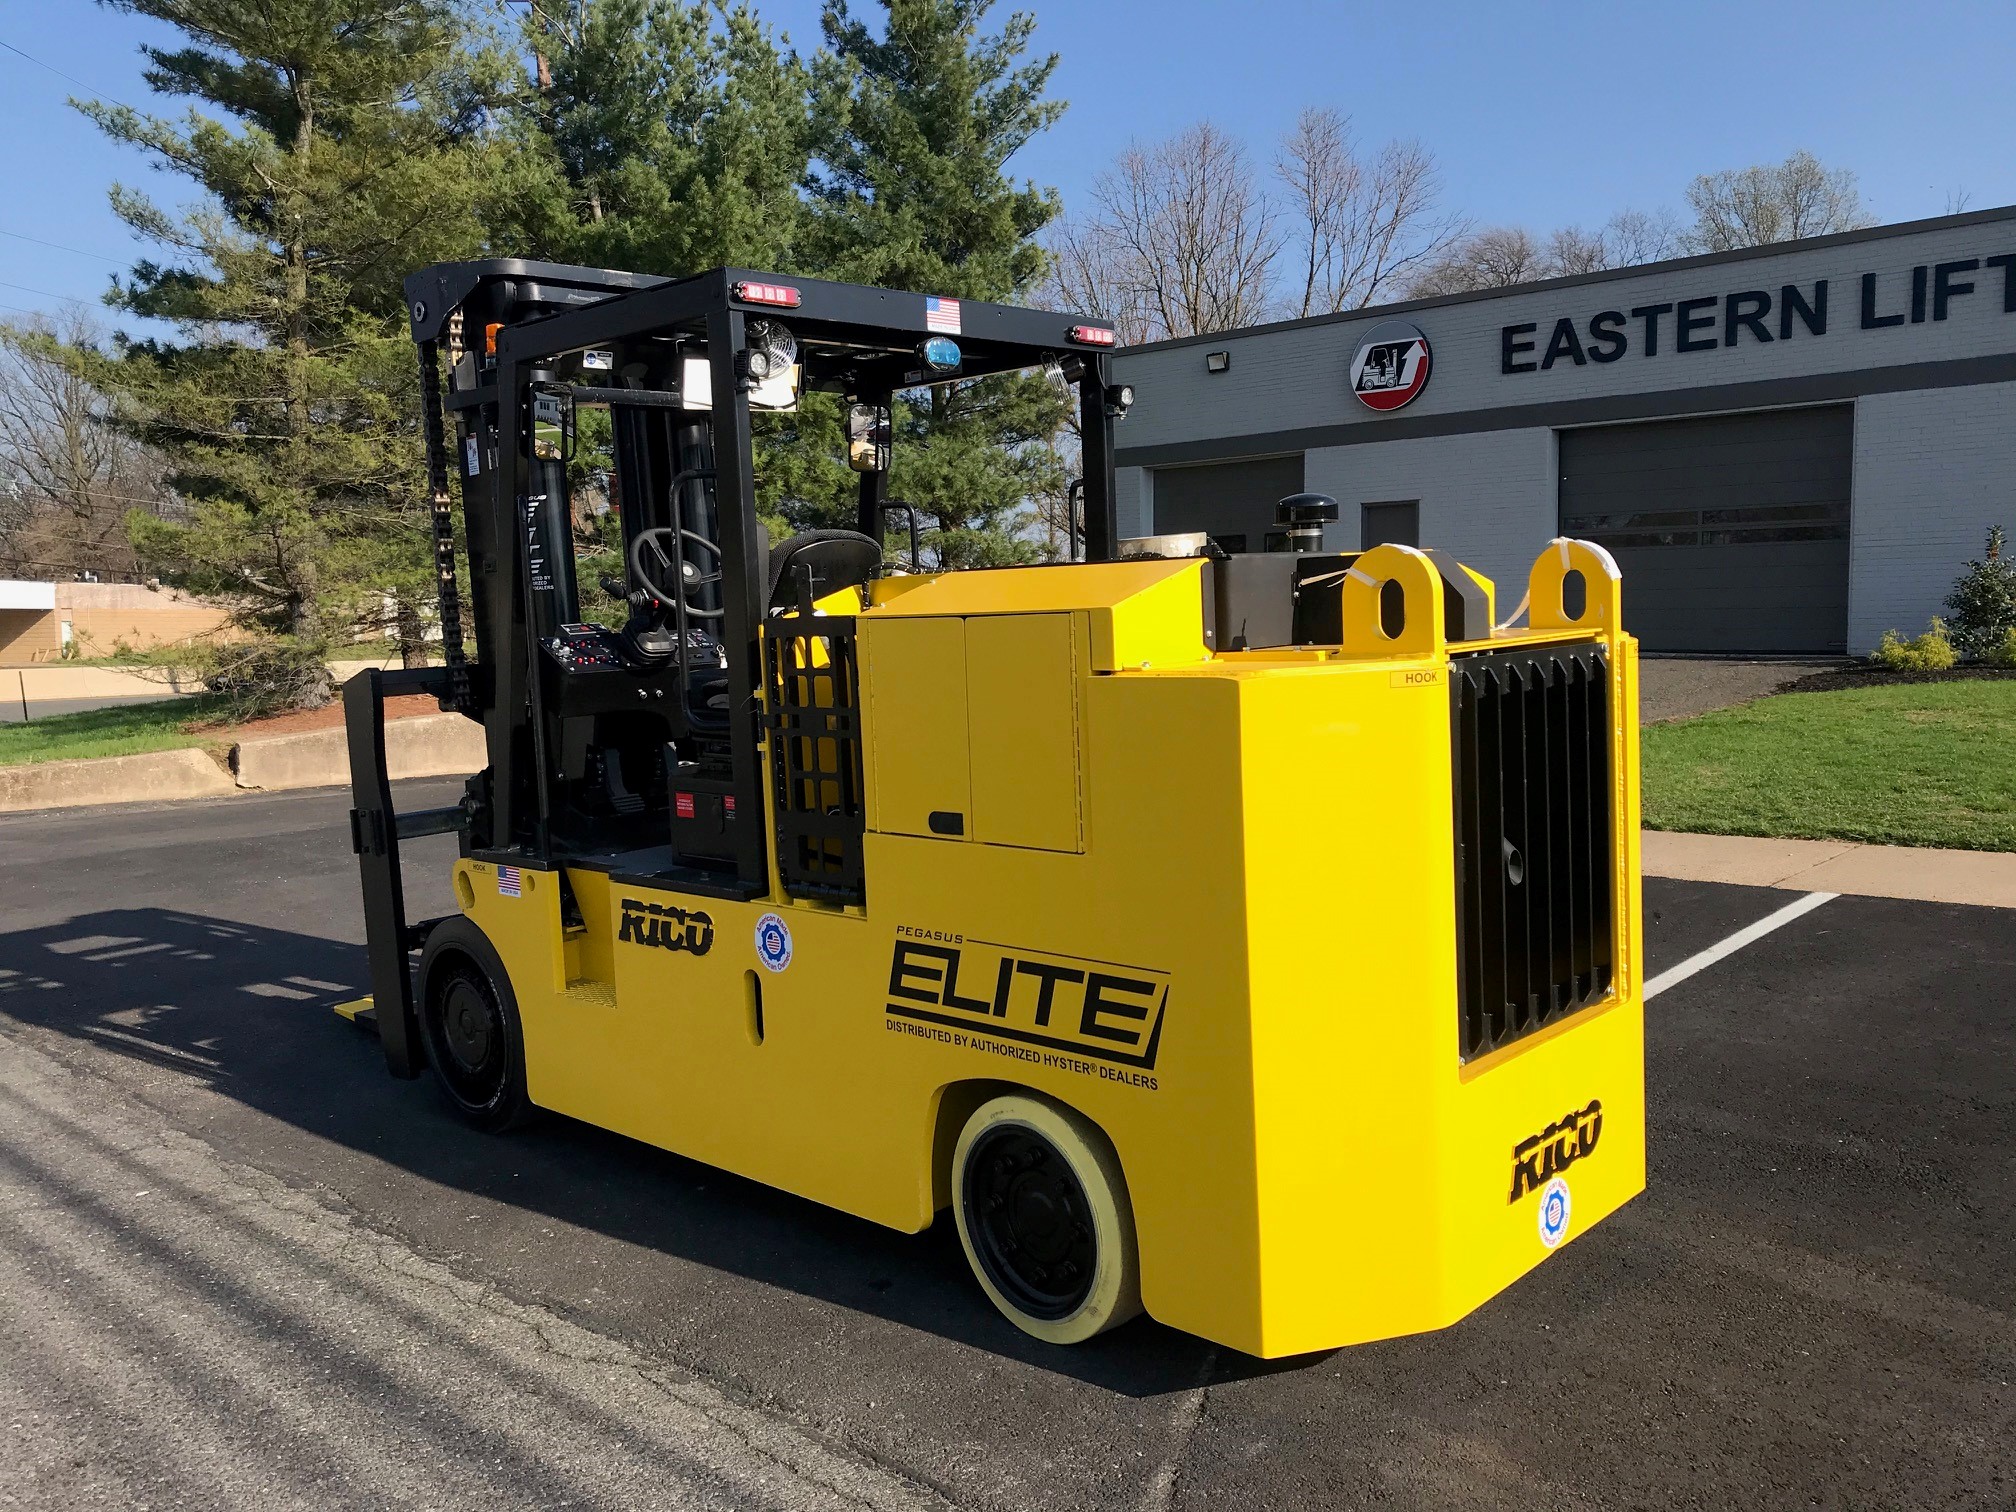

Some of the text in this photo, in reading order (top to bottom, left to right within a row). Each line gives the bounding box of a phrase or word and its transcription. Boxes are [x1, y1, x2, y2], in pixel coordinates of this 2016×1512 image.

[1501, 254, 2016, 374] EASTERN LIFT
[1405, 672, 1438, 684] HOOK
[472, 863, 486, 872] HOOK
[618, 898, 714, 956] RICO
[896, 925, 963, 944] PEGASUS
[757, 945, 778, 971] American
[888, 940, 1157, 1045] ELITE
[886, 1019, 952, 1043] DISTRIBUTED
[954, 1034, 968, 1047] BY
[970, 1038, 1040, 1063] AUTHORIZED
[1100, 1066, 1159, 1091] DEALERS
[1507, 1099, 1603, 1206] RICO
